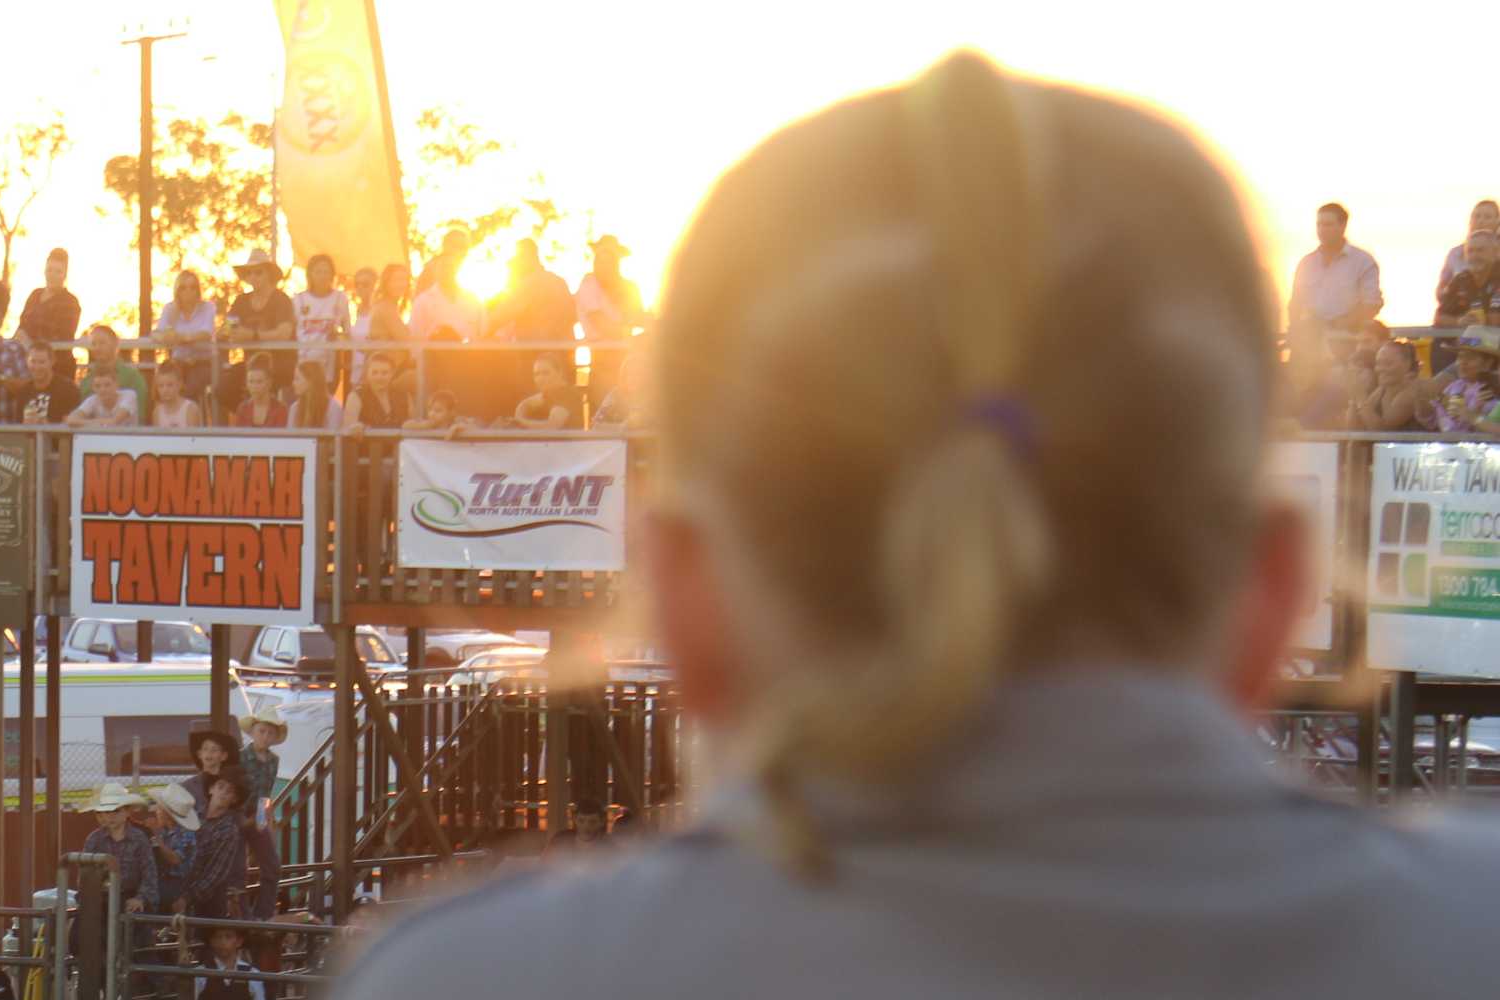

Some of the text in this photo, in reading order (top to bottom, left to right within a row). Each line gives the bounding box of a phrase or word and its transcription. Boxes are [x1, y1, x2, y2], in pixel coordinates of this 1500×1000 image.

[81, 452, 306, 520] NOONAMAH
[1463, 459, 1500, 494] TAN
[467, 507, 499, 516] NORTH
[501, 507, 562, 516] AUSTRALIAN
[81, 518, 305, 610] TAVERN
